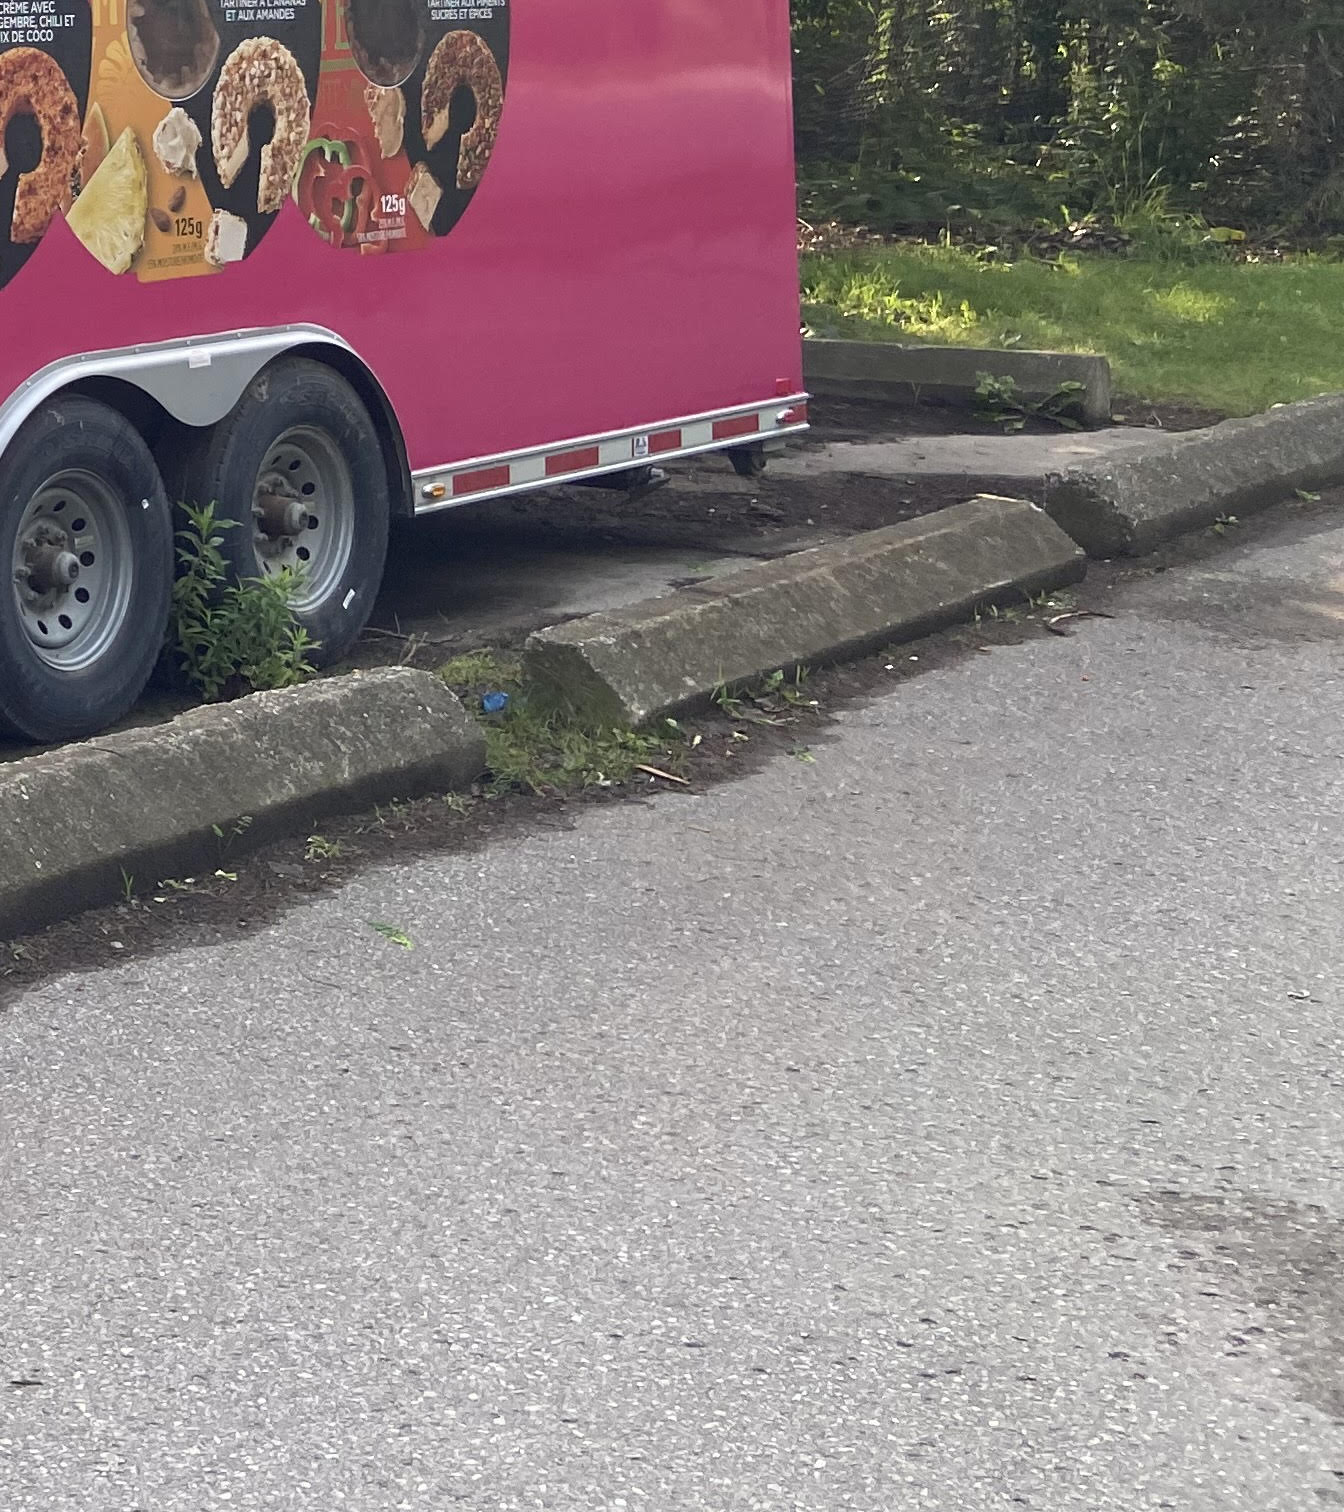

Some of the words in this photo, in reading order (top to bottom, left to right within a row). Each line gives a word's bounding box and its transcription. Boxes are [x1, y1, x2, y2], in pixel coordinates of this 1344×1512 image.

[30, 1, 56, 14] AVEC
[458, 9, 468, 20] ET
[39, 15, 63, 28] CHILI
[64, 14, 75, 27] ET
[225, 9, 237, 22] ET
[237, 9, 254, 21] AUX
[255, 8, 295, 20] AMANDES
[11, 30, 25, 43] DE
[26, 29, 54, 42] COCO
[380, 193, 406, 216] 125g
[175, 217, 203, 239] 125g
